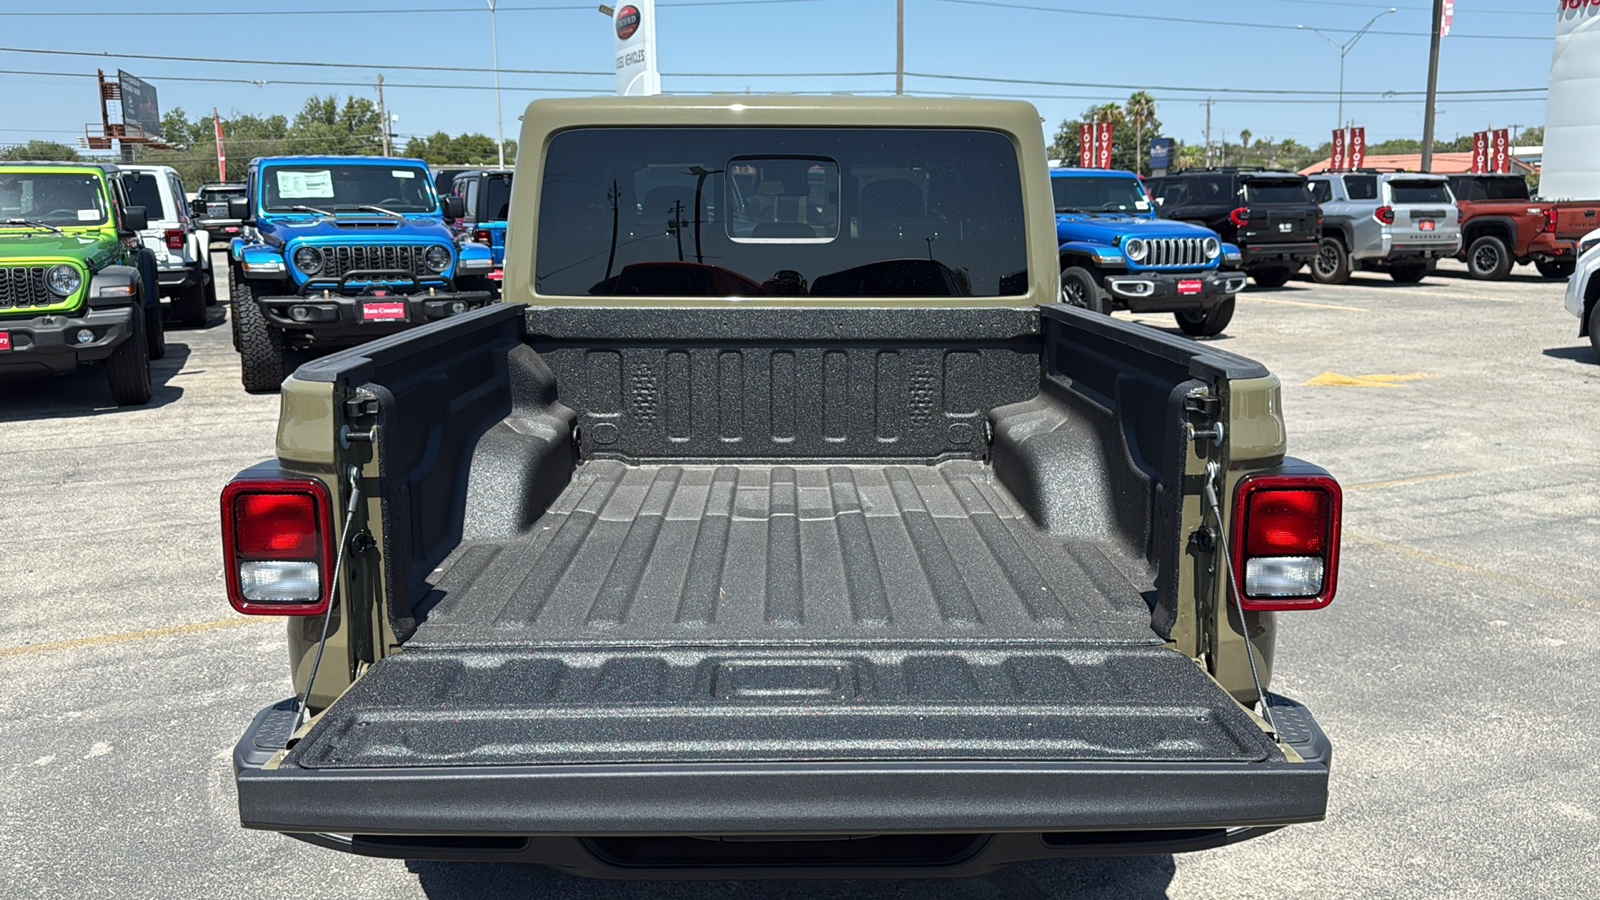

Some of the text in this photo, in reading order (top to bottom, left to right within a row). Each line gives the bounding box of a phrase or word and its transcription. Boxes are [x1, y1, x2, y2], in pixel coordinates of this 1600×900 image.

[1083, 125, 1091, 168] TOYOT
[1101, 122, 1109, 168] TOYOT
[1334, 131, 1343, 170] TOYOT
[1352, 129, 1362, 168] TOYOT
[378, 306, 402, 315] Country
